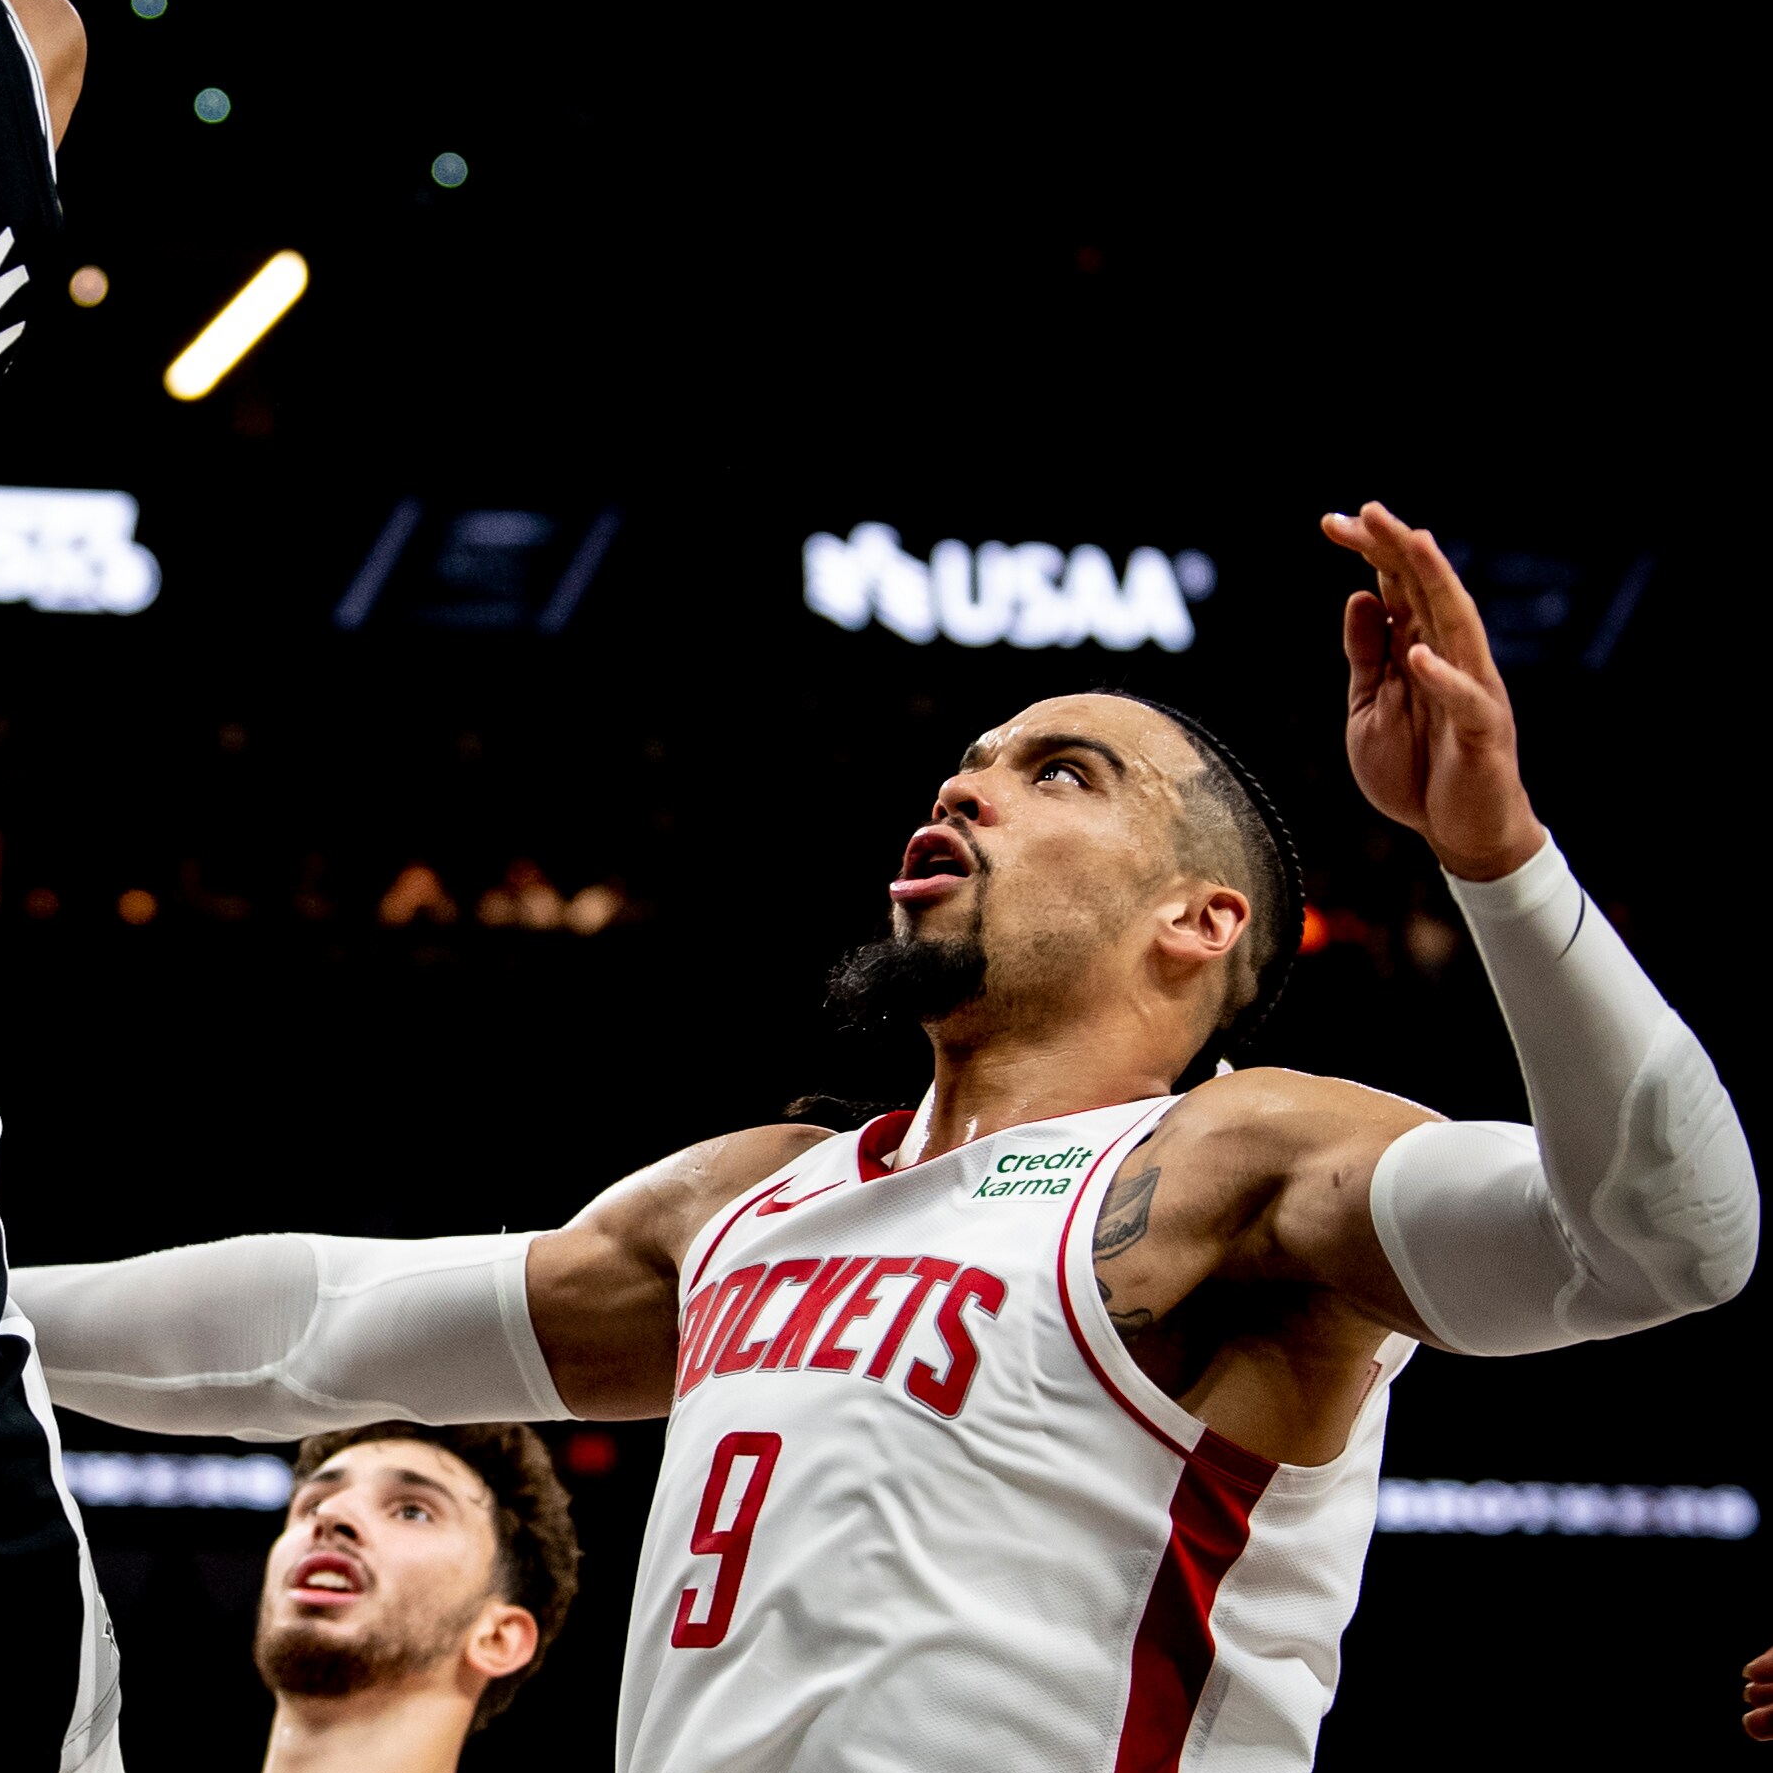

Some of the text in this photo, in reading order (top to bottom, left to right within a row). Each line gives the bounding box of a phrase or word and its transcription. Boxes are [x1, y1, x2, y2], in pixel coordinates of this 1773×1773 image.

[929, 538, 1195, 653] USAA
[971, 1176, 1072, 1199] karma
[996, 1146, 1093, 1174] credit
[670, 1431, 783, 1649] 9
